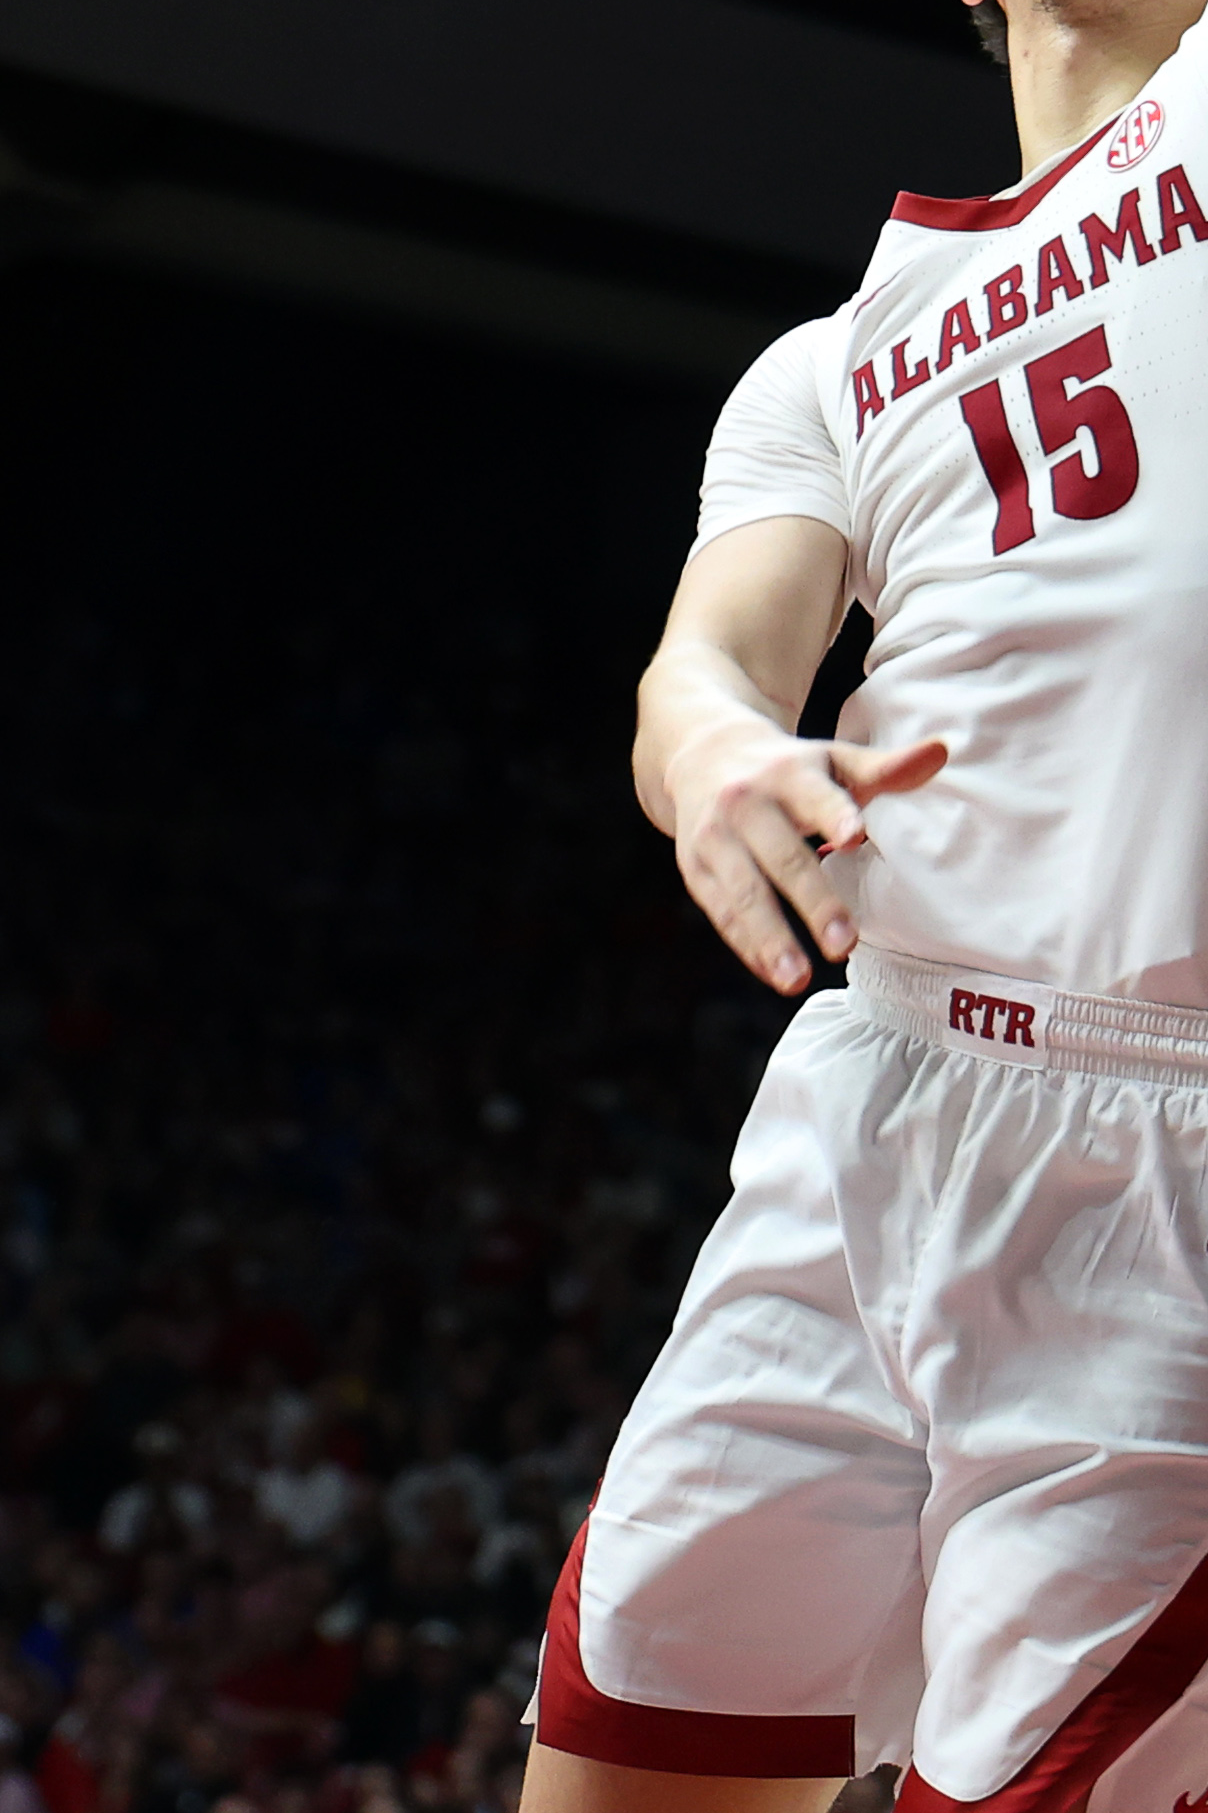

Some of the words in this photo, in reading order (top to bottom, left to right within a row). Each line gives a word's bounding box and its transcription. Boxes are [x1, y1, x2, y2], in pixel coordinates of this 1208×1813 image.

[1107, 99, 1161, 168] SEC
[959, 323, 1140, 558] 15
[949, 987, 1035, 1048] RTR
